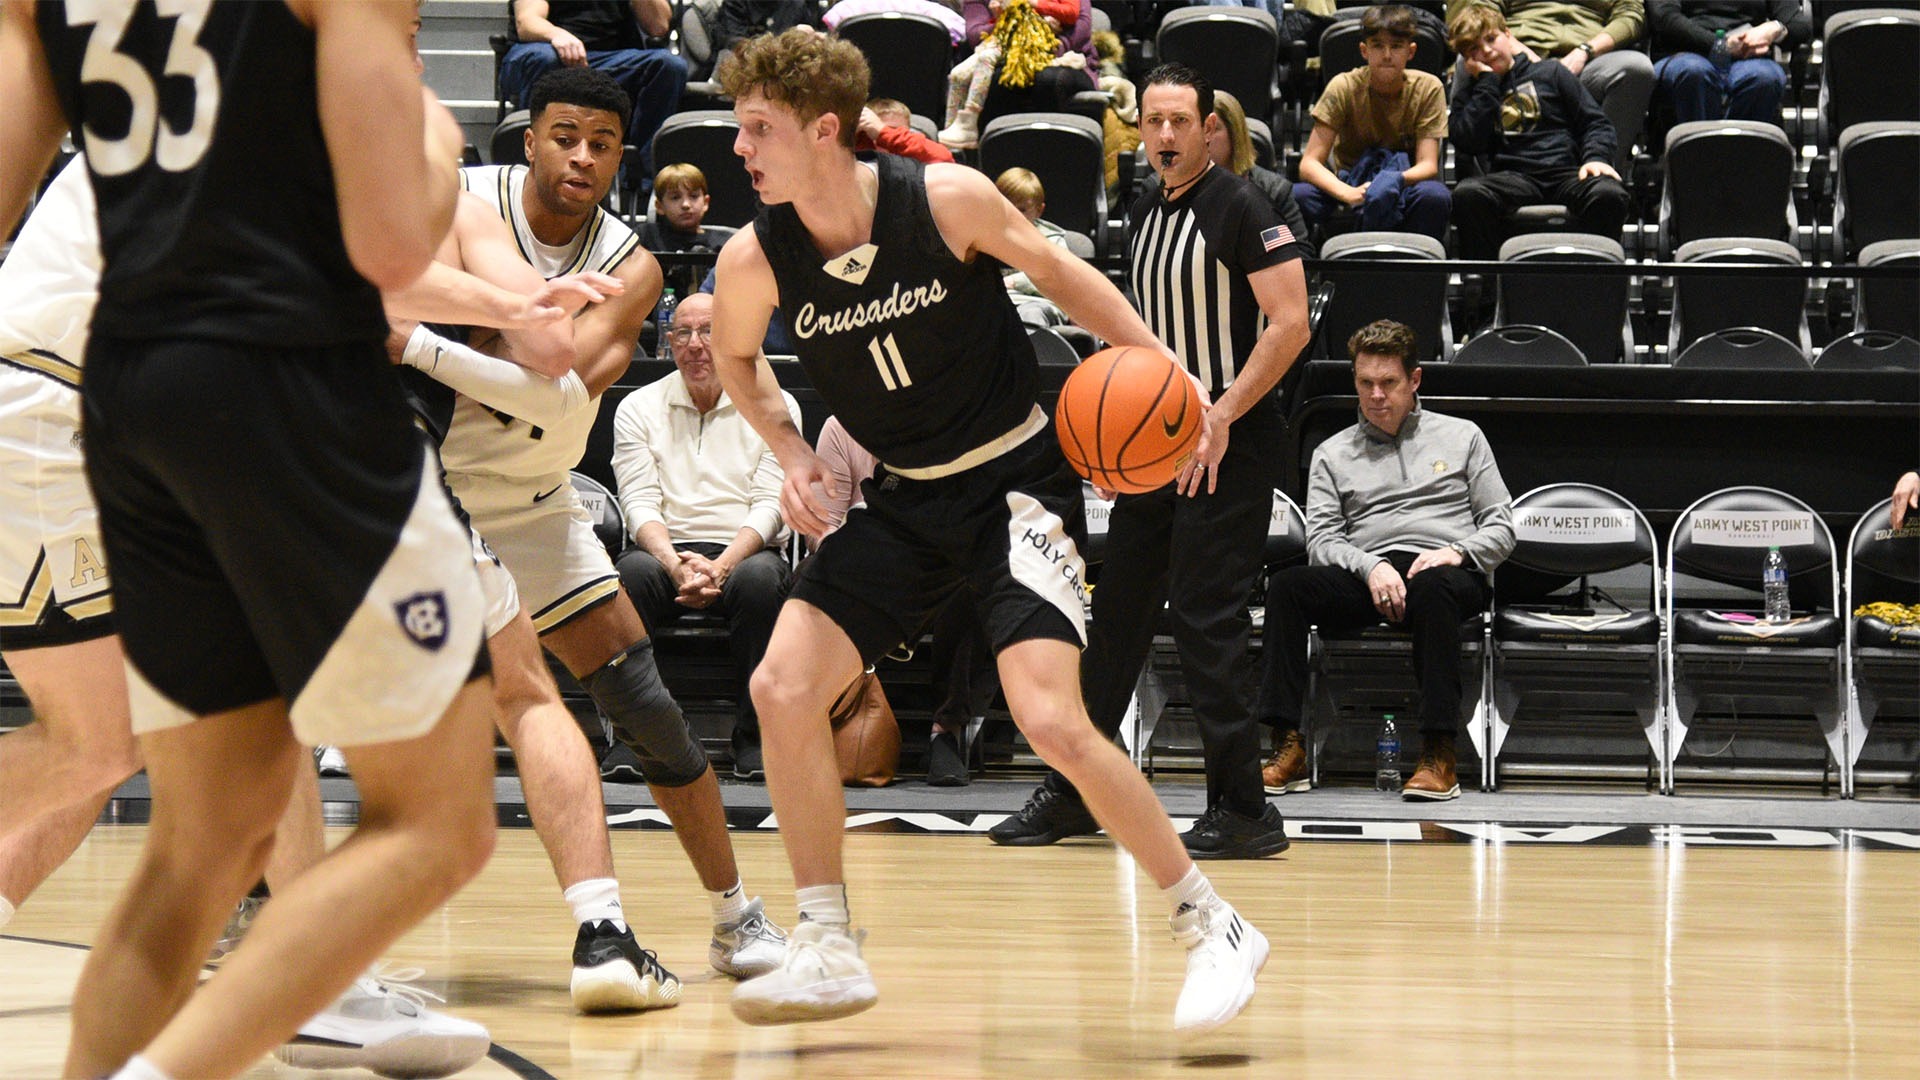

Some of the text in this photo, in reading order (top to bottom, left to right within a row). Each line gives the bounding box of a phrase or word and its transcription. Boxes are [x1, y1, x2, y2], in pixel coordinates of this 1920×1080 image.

[64, 0, 222, 177] 33
[842, 264, 867, 277] adidas
[795, 278, 948, 340] Crusaders
[867, 332, 913, 392] 11
[1085, 508, 1111, 520] POIN
[1553, 517, 1590, 529] WEST
[1593, 516, 1632, 529] POINT
[1694, 518, 1810, 532] ARMY WEST POINT
[70, 537, 108, 589] A
[1021, 528, 1086, 606] HOLY CRO
